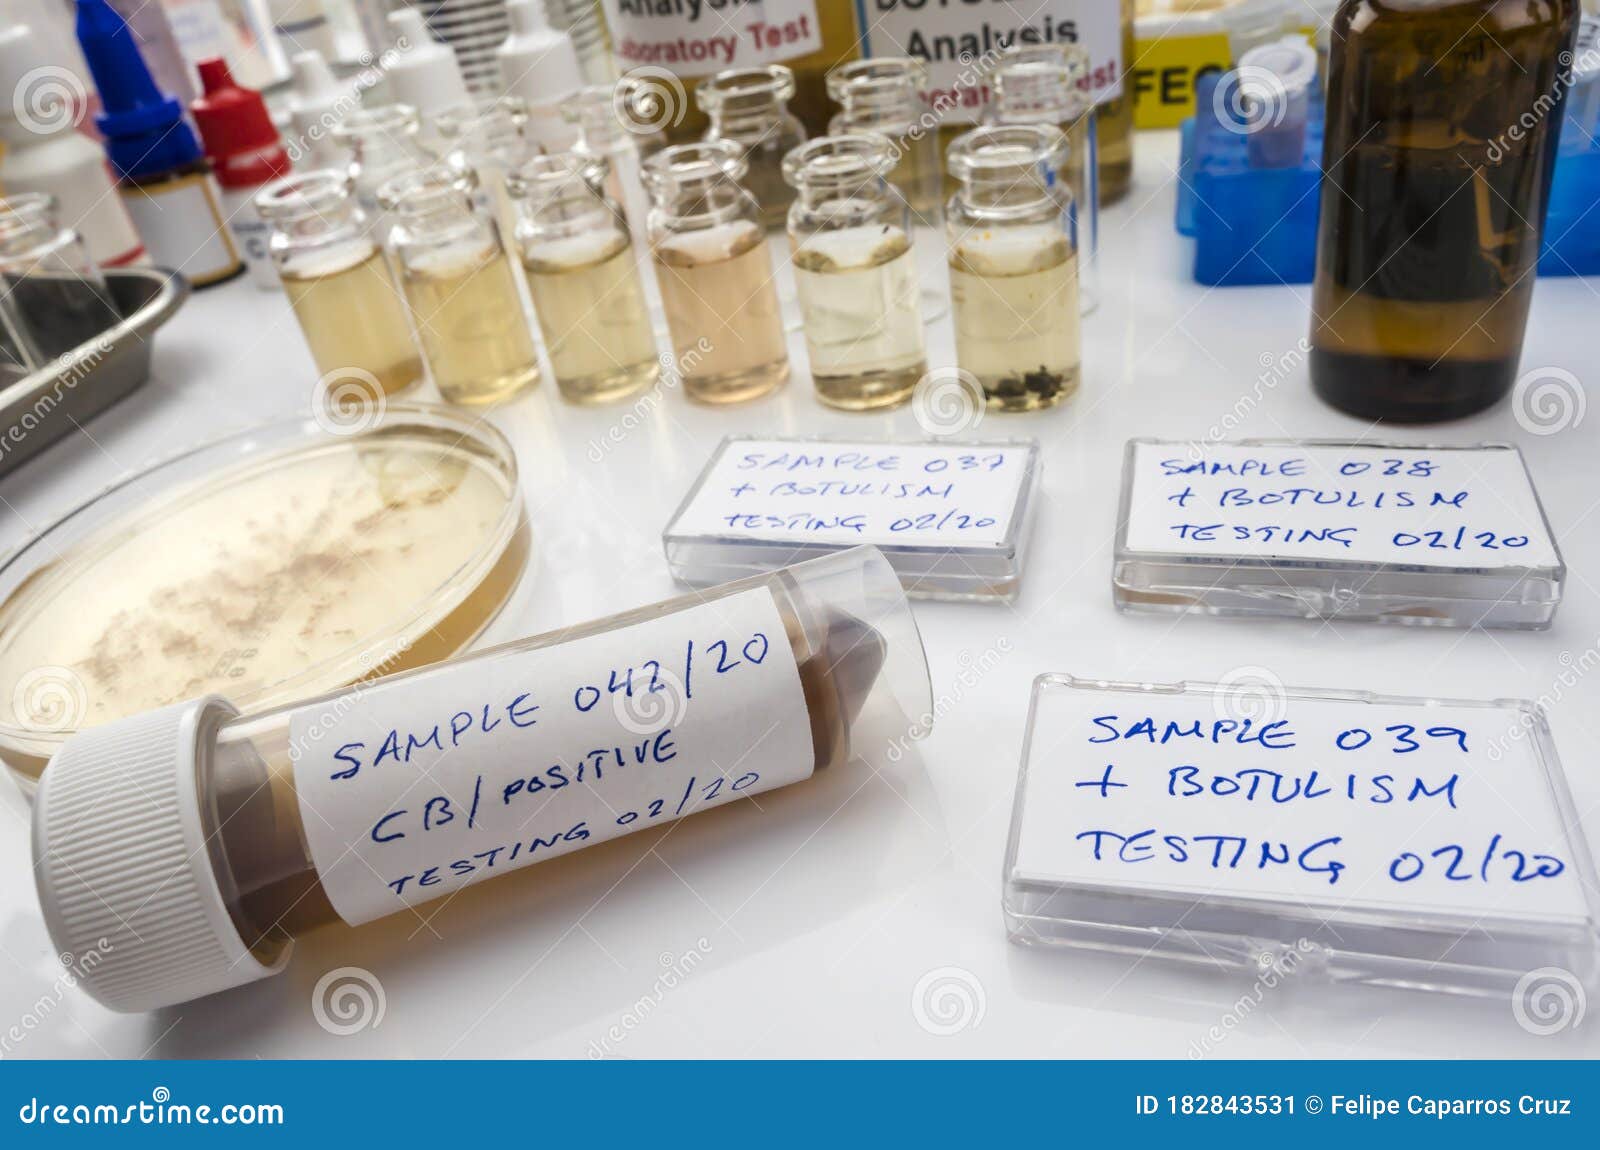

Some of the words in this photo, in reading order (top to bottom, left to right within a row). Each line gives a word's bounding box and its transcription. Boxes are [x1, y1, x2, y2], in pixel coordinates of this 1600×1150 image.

[748, 15, 809, 51] Test
[737, 453, 899, 471] SAMPLE
[924, 455, 1005, 473] 037
[1160, 459, 1306, 477] SAMPLE
[1339, 458, 1440, 477] 038
[771, 482, 953, 498] BOTULISM
[1219, 487, 1469, 510] BOTULISM
[724, 512, 867, 532] TESTING
[889, 508, 996, 532] 02/20
[1170, 523, 1358, 549] TESTING
[1391, 525, 1530, 551] 02/20
[330, 693, 540, 781] SAMPLE
[574, 632, 769, 713] 042/20
[1087, 715, 1297, 750] SAMPLE
[1335, 724, 1470, 754] 039
[1075, 764, 1128, 799] +
[1167, 765, 1460, 809] BOTULISM
[388, 821, 591, 896] TESTING
[616, 771, 761, 827] 02/20
[1075, 828, 1347, 886] TESTING
[1388, 832, 1567, 885] 02/20
